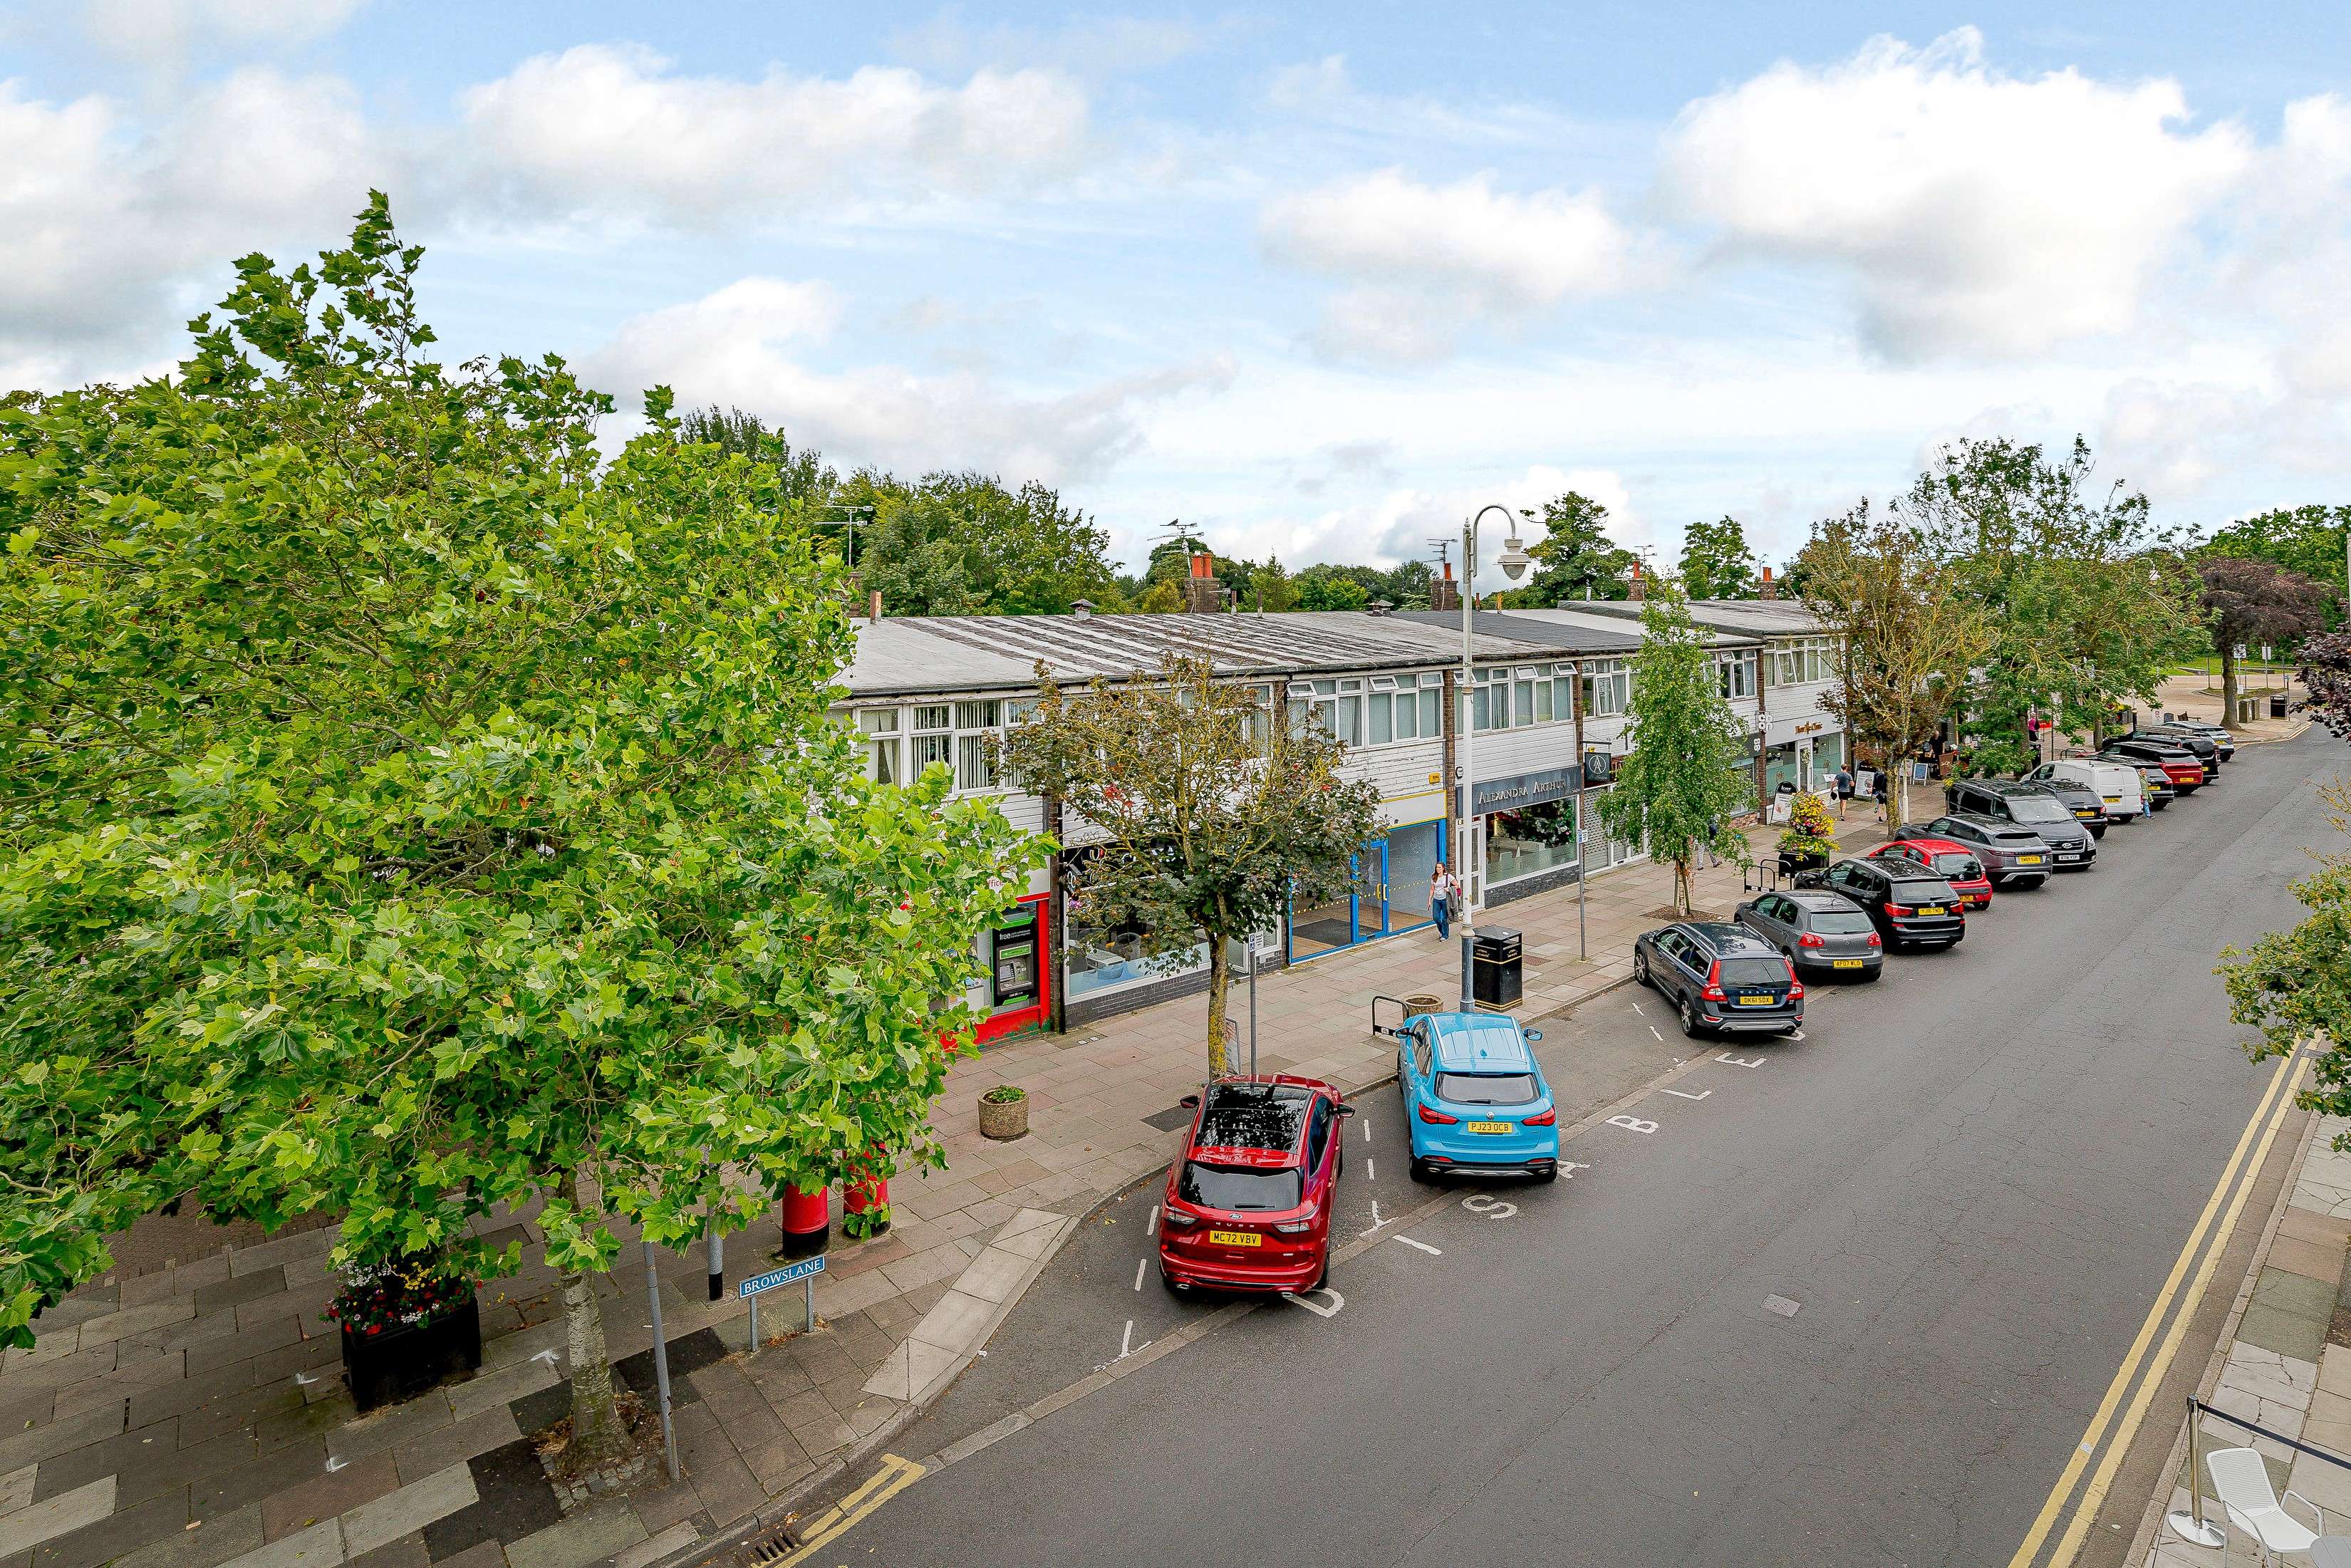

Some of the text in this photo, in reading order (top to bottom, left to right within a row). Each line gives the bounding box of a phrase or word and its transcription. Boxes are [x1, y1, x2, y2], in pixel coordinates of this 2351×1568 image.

[988, 879, 1004, 888] ffice
[1471, 1123, 1492, 1131] PJ23
[1213, 1232, 1257, 1245] MC72 VBV
